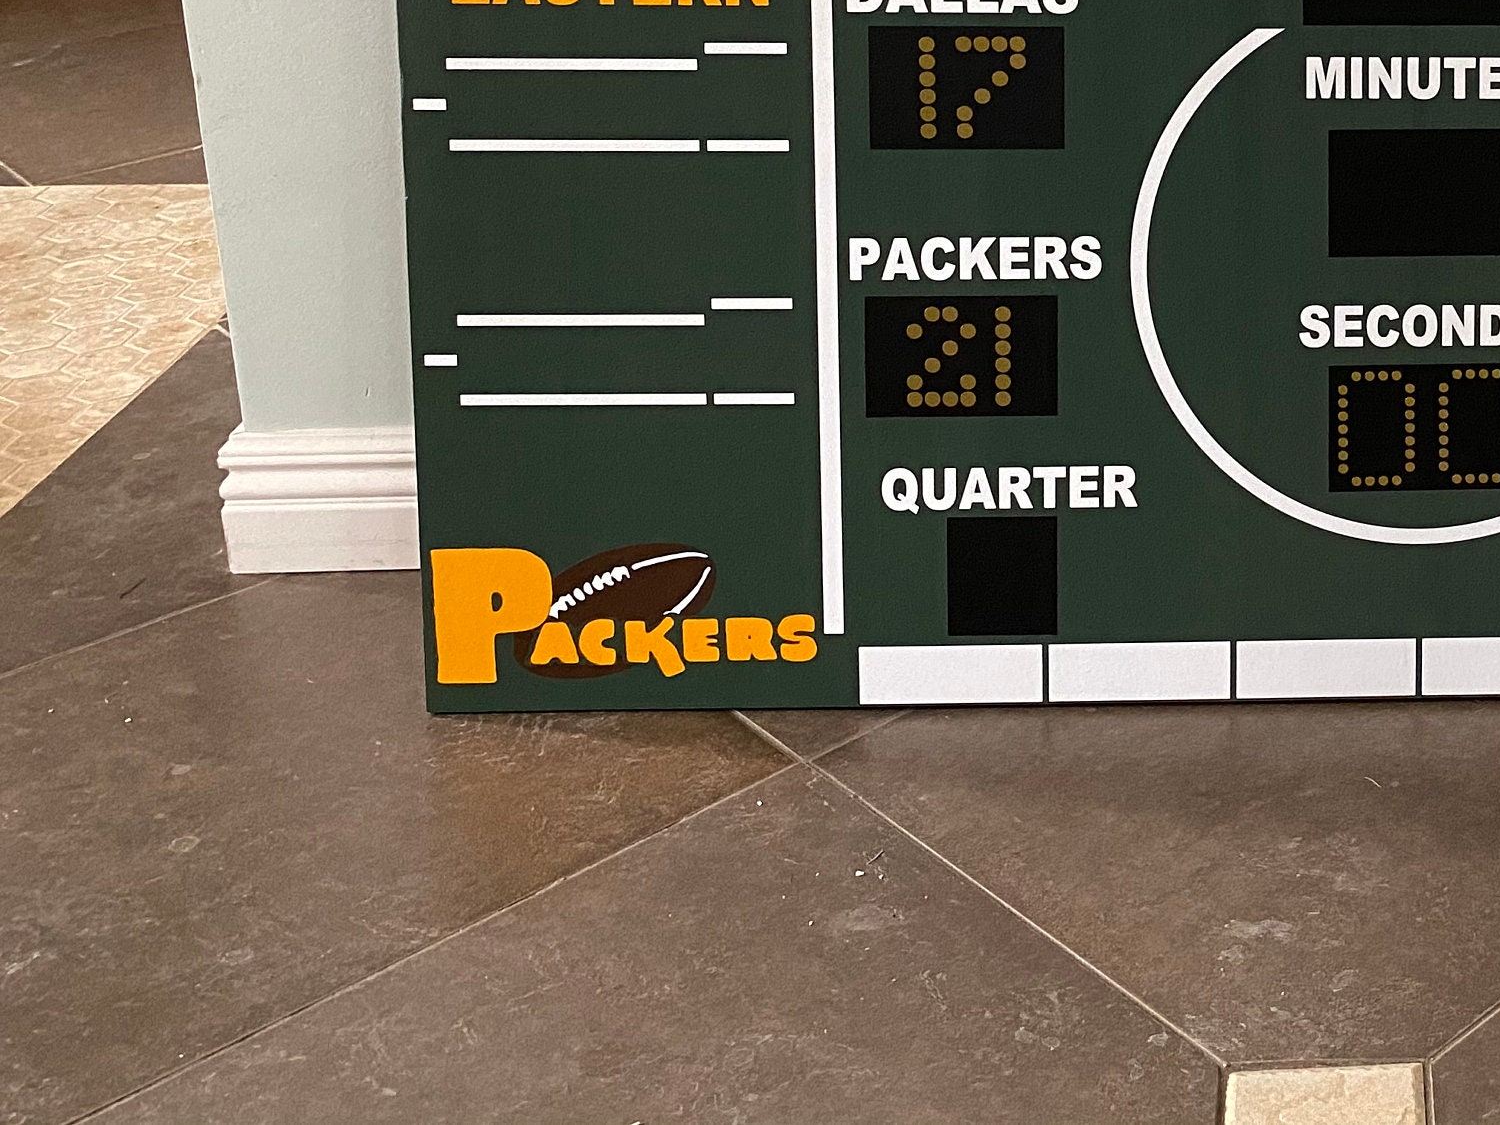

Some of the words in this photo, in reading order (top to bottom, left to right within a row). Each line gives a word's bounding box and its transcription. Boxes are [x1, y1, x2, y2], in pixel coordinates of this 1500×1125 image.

[918, 35, 1026, 139] 17
[848, 235, 1103, 281] PACKERS
[906, 306, 1012, 410] 21
[880, 465, 1139, 513] QUARTER
[430, 546, 818, 685] PACKERS
